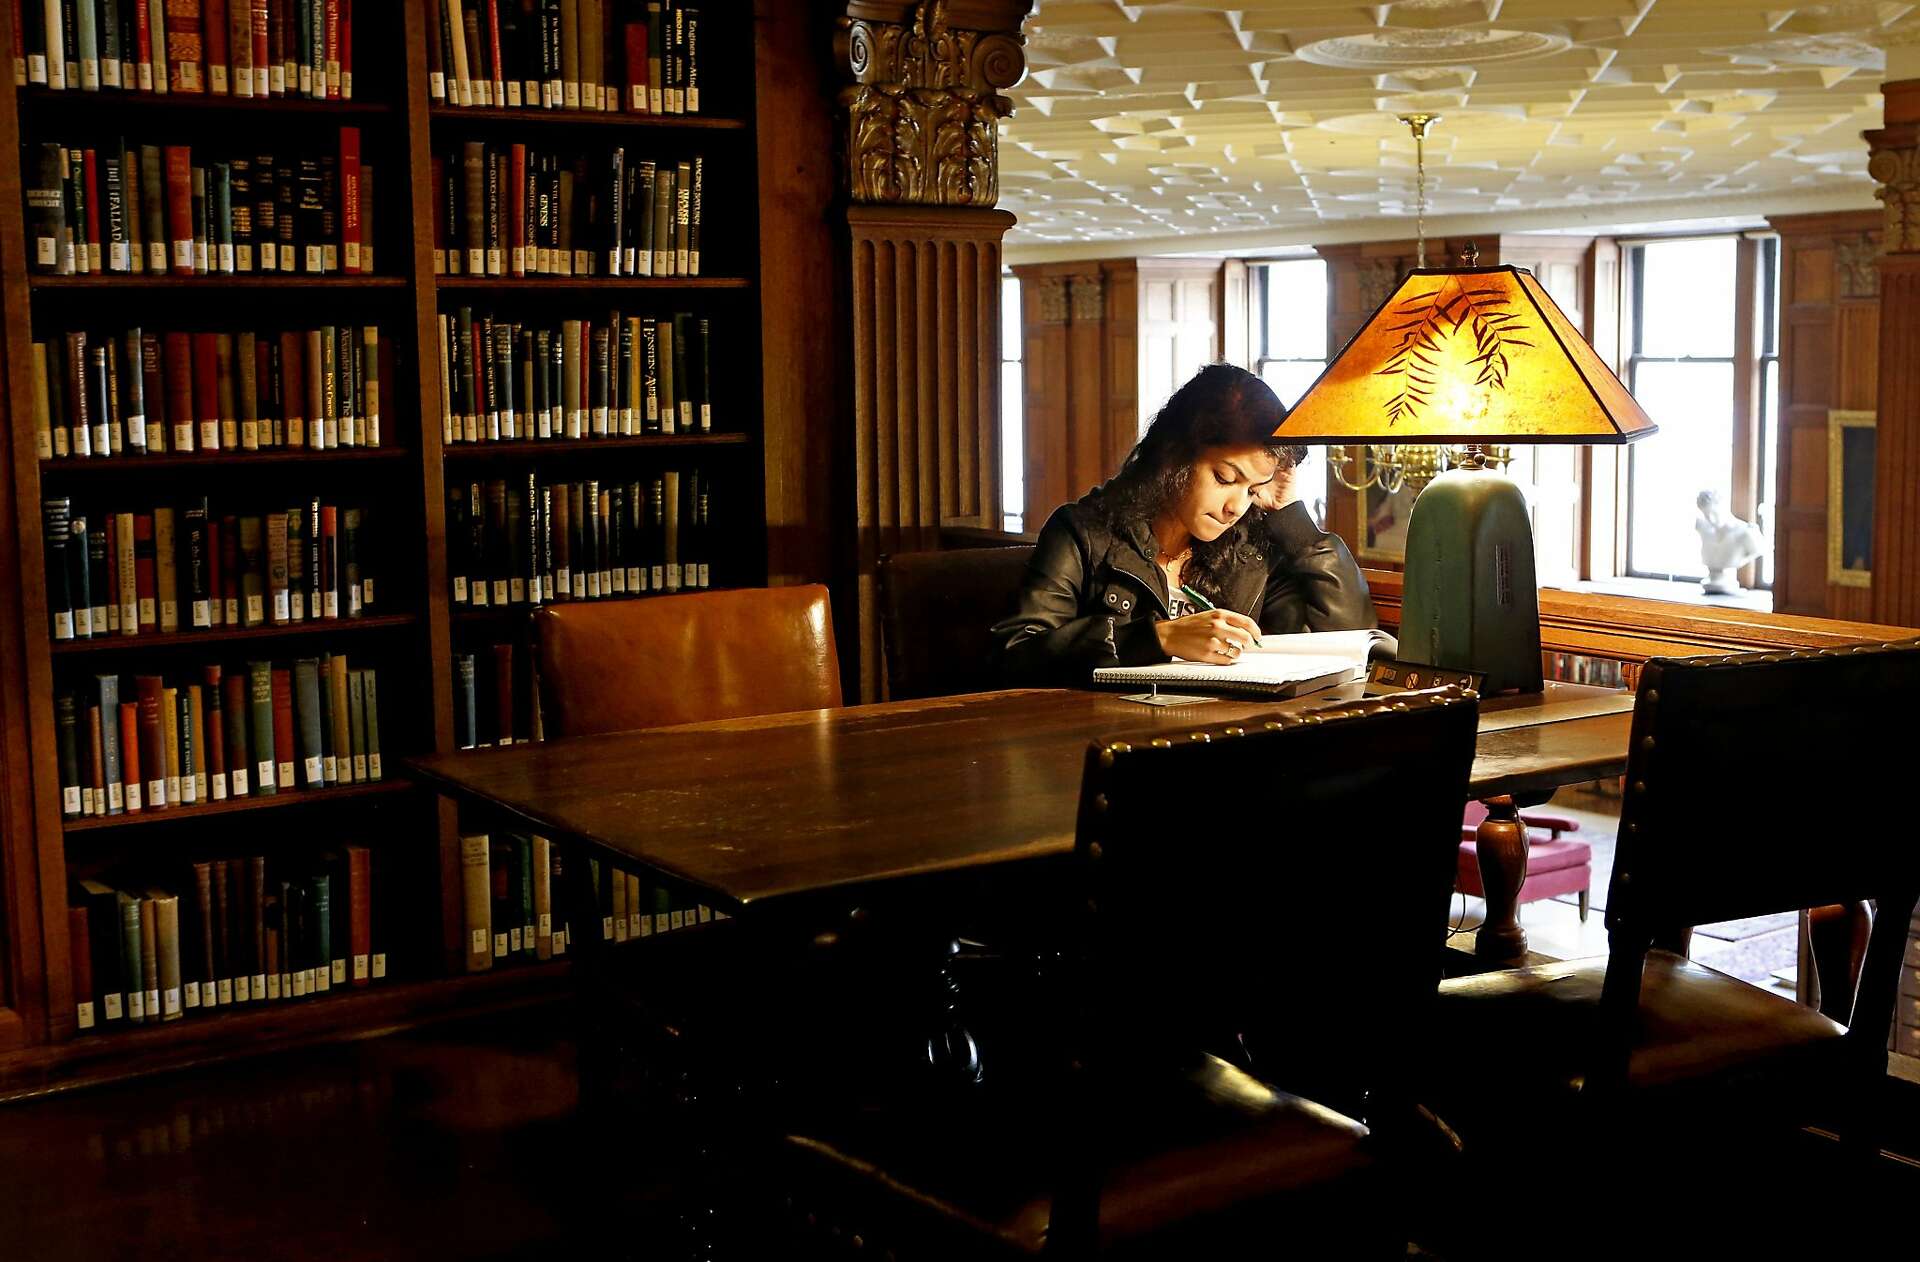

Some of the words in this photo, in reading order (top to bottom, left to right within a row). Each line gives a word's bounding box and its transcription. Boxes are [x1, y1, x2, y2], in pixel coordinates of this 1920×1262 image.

[688, 20, 698, 56] Engines
[109, 197, 122, 242] FALLAD
[540, 193, 549, 227] GENESIS
[340, 327, 352, 370] Alexander
[643, 327, 656, 370] EINSTEIN
[342, 399, 351, 416] The
